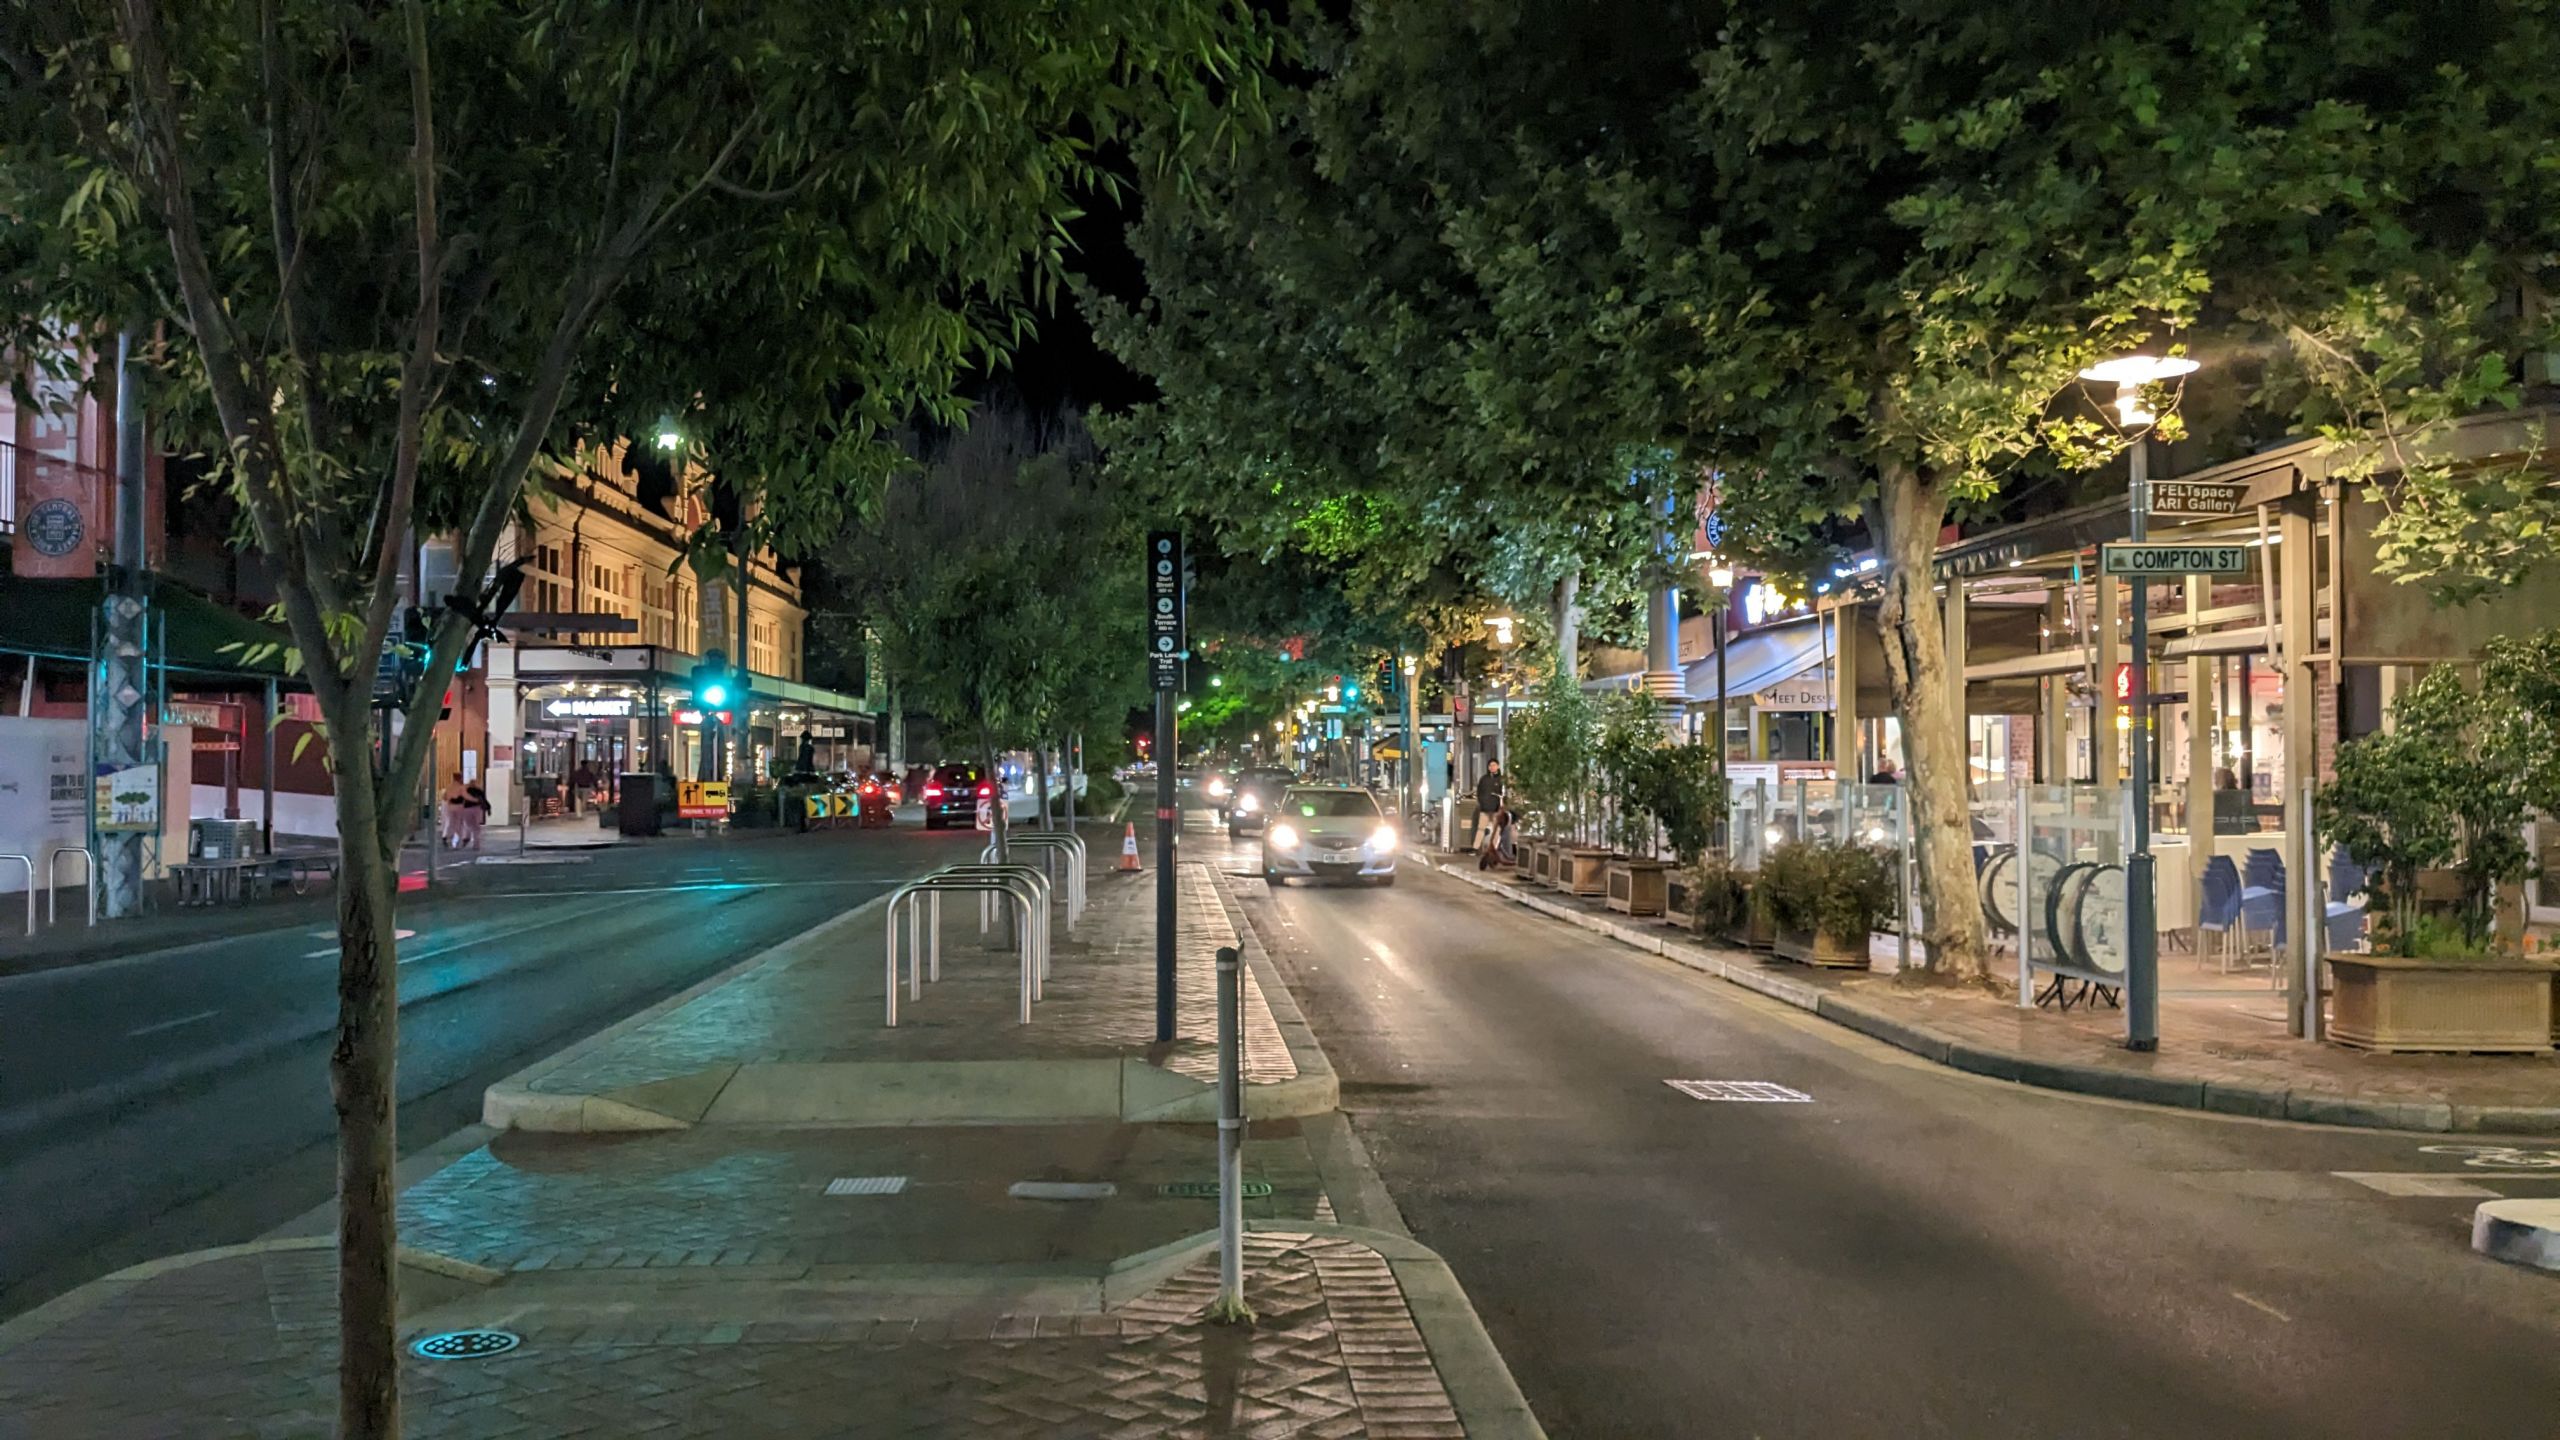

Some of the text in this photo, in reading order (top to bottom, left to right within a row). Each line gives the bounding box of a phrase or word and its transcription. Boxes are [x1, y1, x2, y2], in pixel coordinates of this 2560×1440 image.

[2158, 484, 2235, 499] FELTspace
[2156, 498, 2237, 513] ARI Gallery
[2132, 550, 2239, 569] COMPTON ST
[571, 700, 632, 716] MARKET
